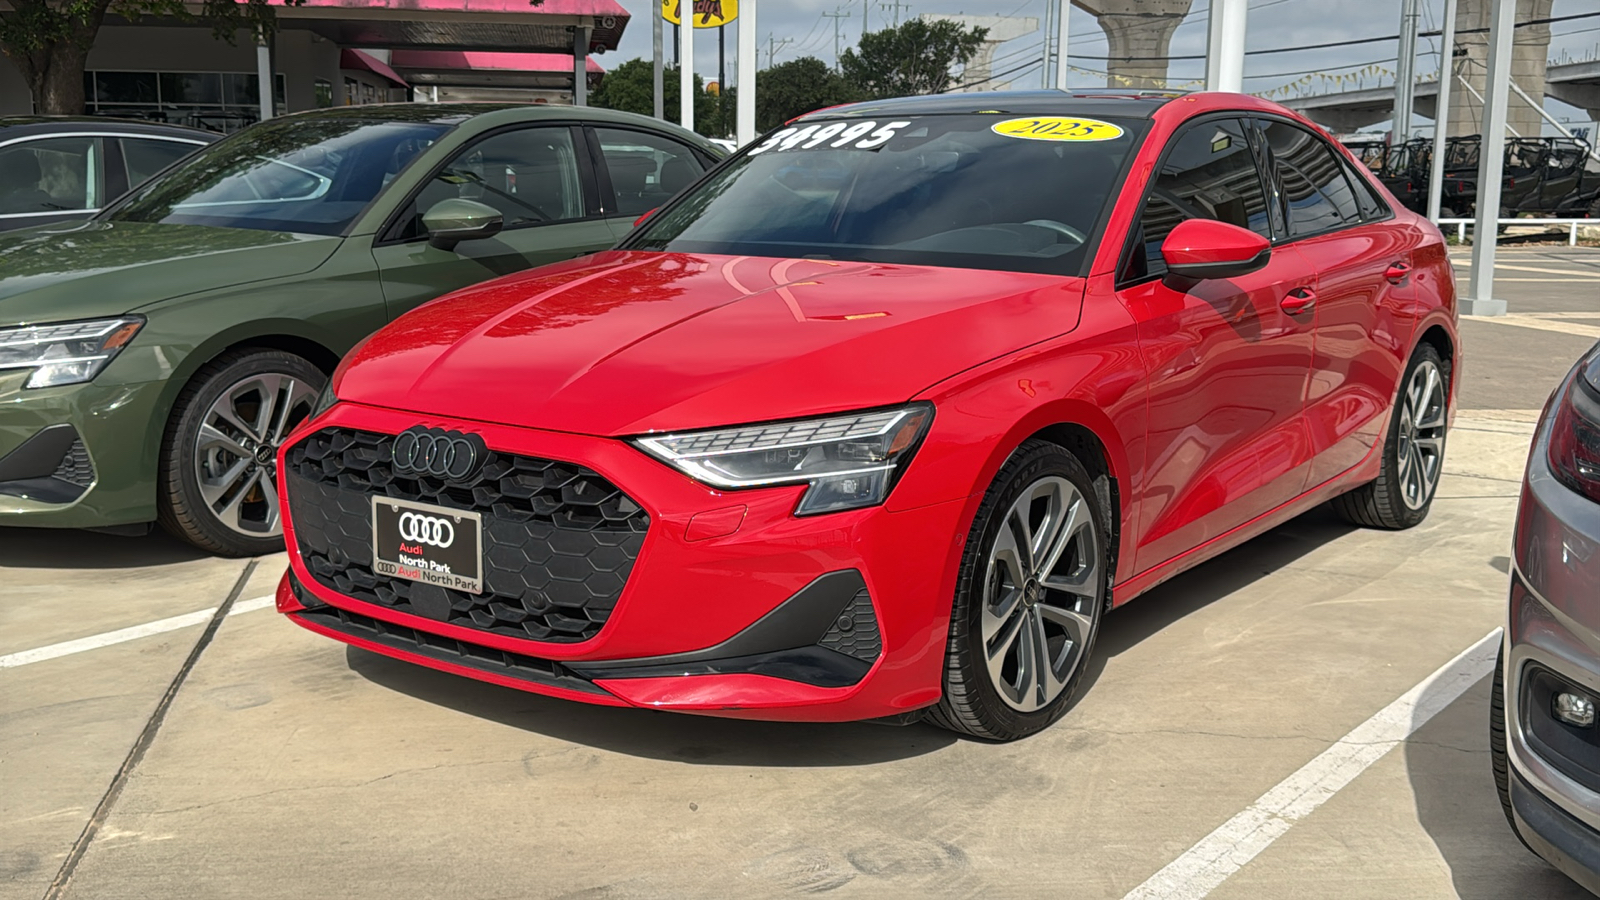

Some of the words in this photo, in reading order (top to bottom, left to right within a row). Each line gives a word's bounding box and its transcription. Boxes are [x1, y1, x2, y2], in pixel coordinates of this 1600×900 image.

[747, 121, 911, 156] 34995
[1008, 121, 1104, 136] 2025
[399, 543, 423, 555] Audi
[399, 554, 428, 569] North
[430, 560, 451, 574] Park
[397, 566, 421, 579] Audi
[423, 571, 453, 586] North
[455, 578, 477, 591] Park
